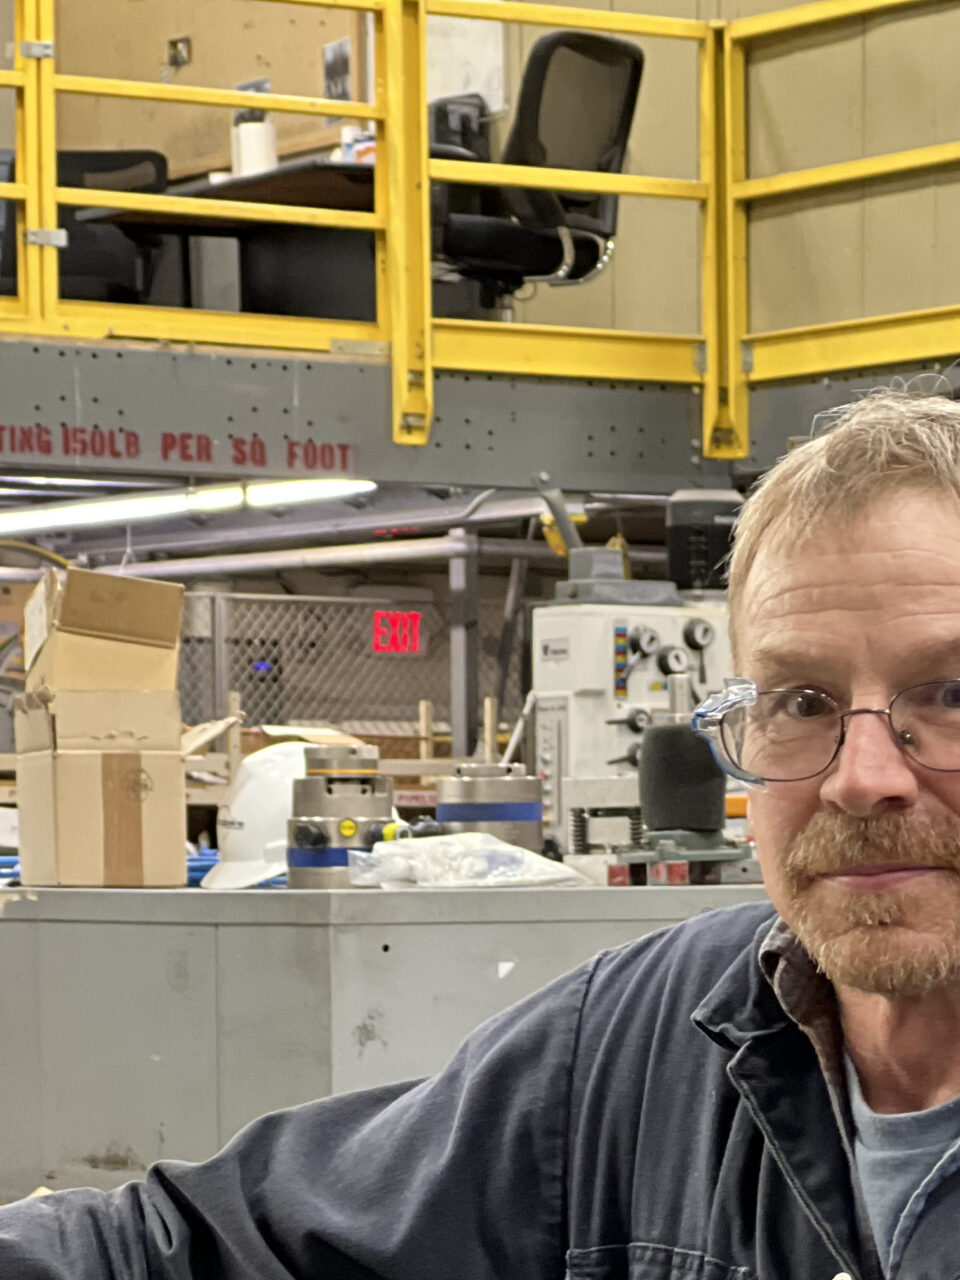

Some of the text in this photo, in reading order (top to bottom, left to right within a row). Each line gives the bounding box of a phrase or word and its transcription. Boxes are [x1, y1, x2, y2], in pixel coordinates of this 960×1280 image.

[61, 424, 140, 459] 150LB
[161, 432, 212, 462] PER
[231, 437, 267, 467] SQ
[287, 440, 350, 471] FOOT
[373, 610, 422, 652] EXIT
